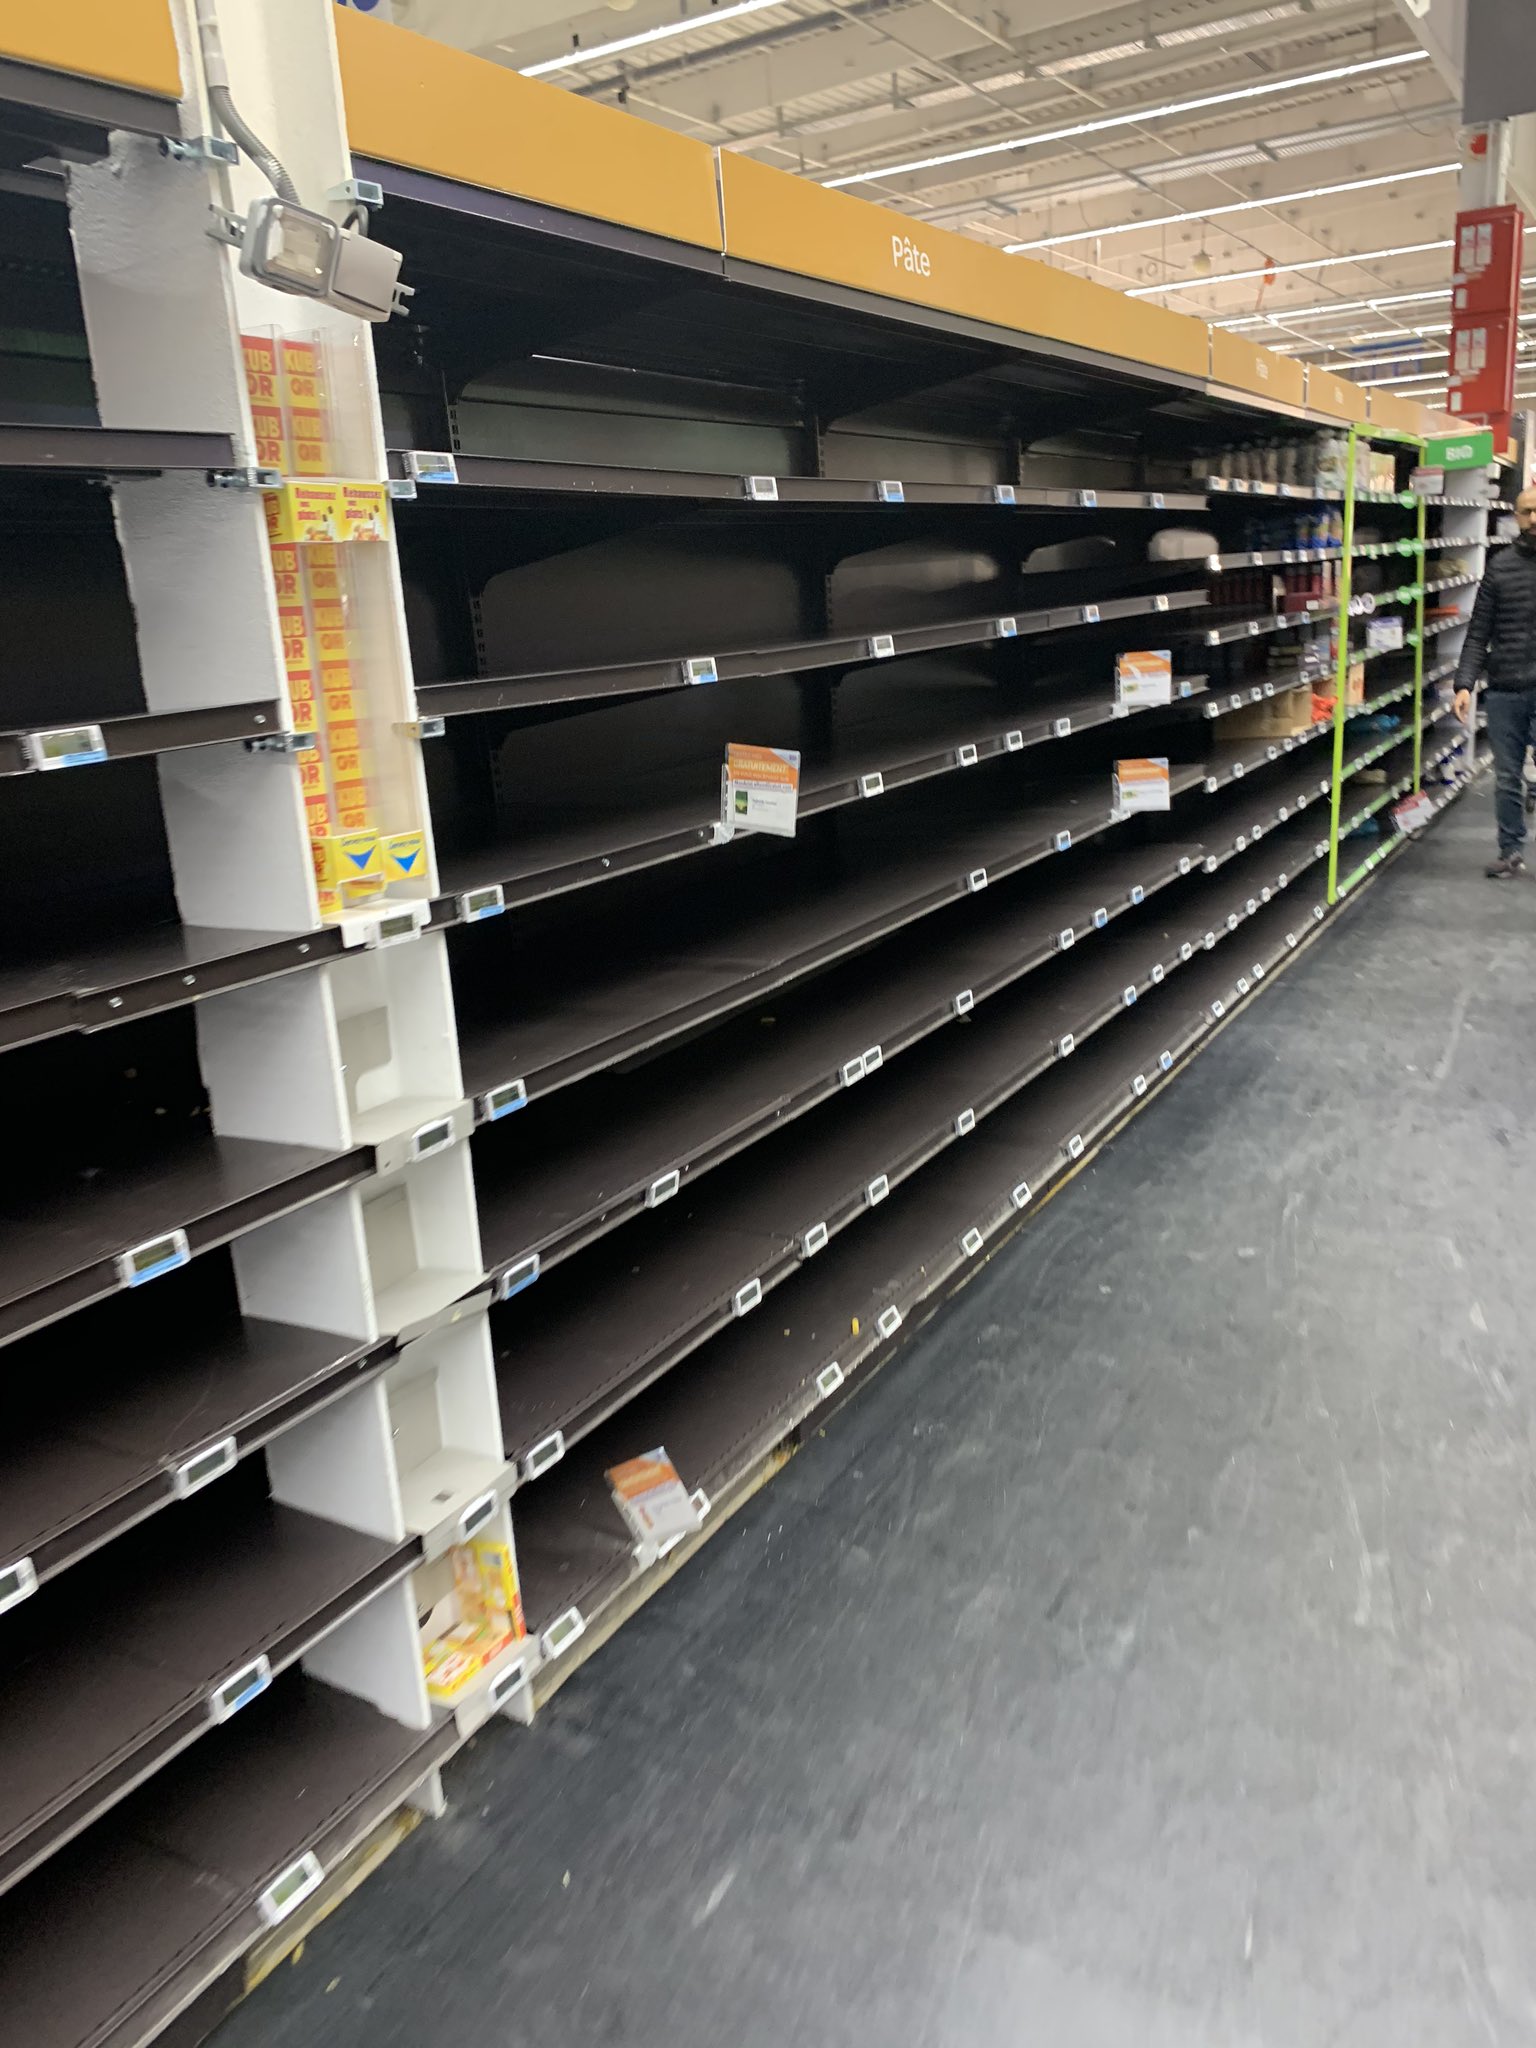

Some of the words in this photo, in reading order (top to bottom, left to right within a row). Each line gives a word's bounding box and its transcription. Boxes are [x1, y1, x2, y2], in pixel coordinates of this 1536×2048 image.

[892, 235, 931, 277] Pâte
[290, 377, 315, 397] OR
[254, 415, 280, 438] UB
[272, 550, 296, 572] UB
[290, 680, 312, 700] UB
